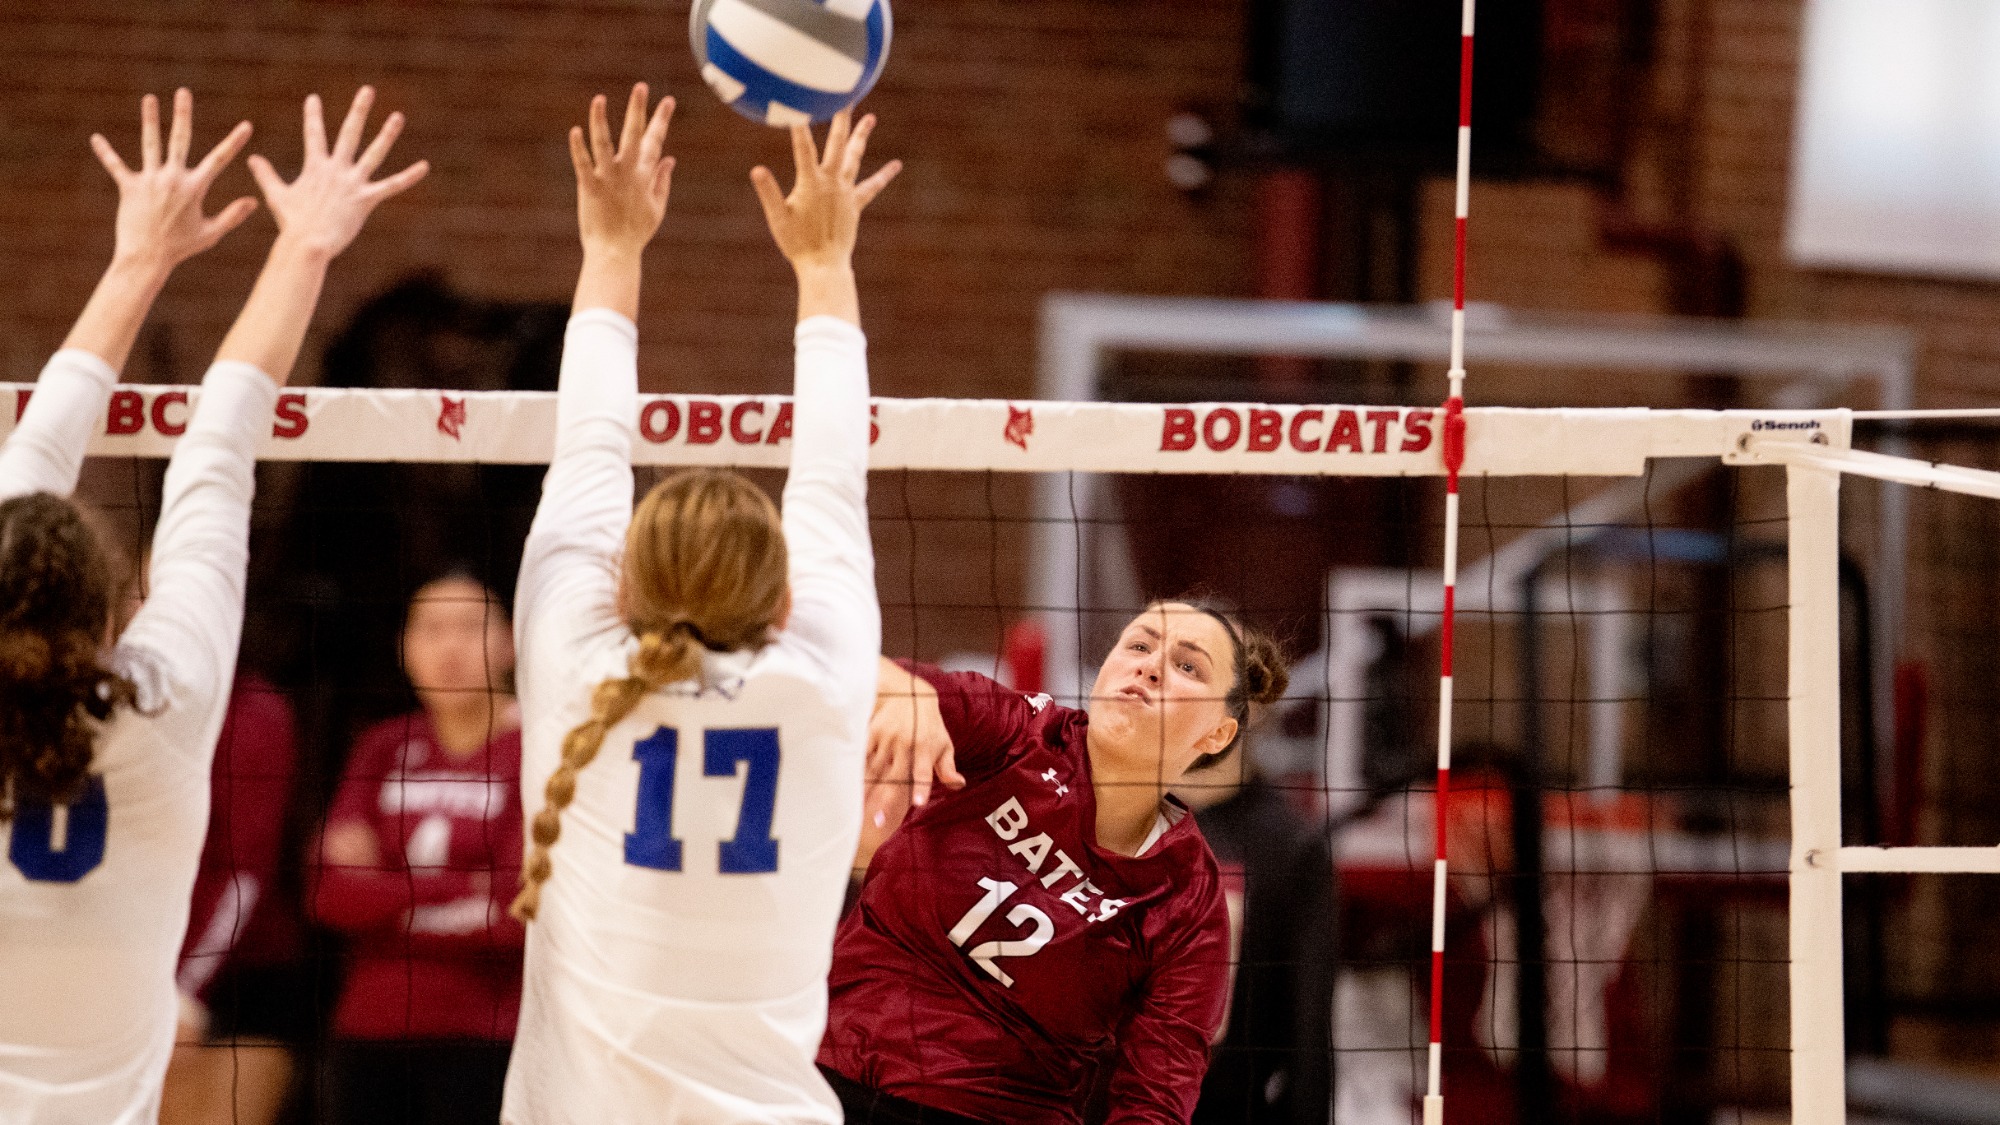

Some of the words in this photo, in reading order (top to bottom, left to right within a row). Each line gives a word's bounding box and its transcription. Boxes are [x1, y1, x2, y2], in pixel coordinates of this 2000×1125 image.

[639, 399, 880, 446] OBCA
[1159, 408, 1434, 453] BOBCATS
[623, 725, 781, 874] 17
[984, 795, 1130, 923] BATES
[947, 876, 1055, 988] 12
